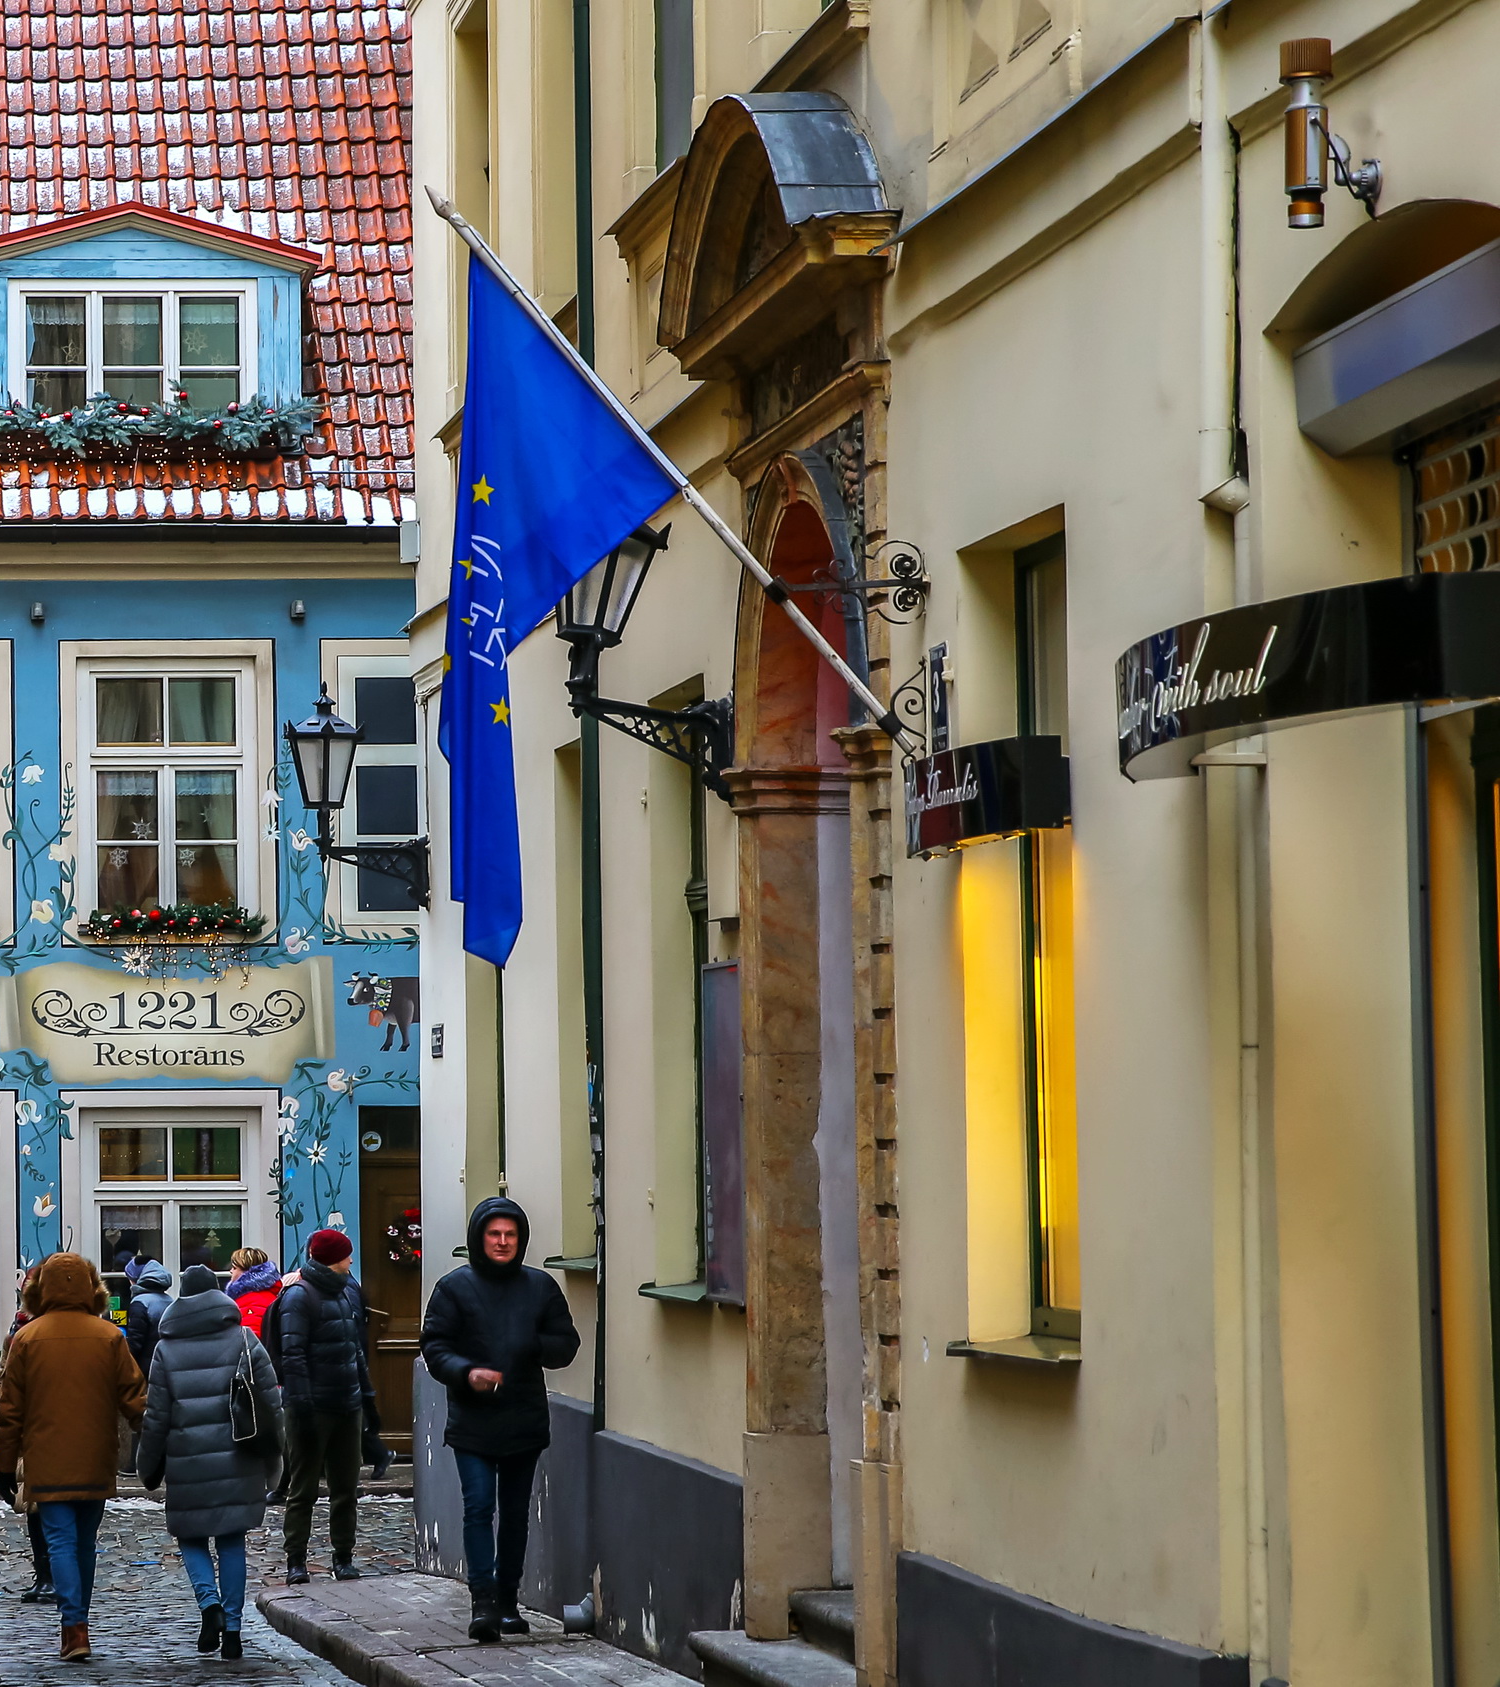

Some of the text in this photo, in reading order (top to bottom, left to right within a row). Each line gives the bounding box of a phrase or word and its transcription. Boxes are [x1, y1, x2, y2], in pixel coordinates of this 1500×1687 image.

[1202, 625, 1278, 705] soul
[931, 671, 941, 714] 3
[109, 990, 227, 1030] 1221
[92, 1041, 246, 1067] Restorāns
